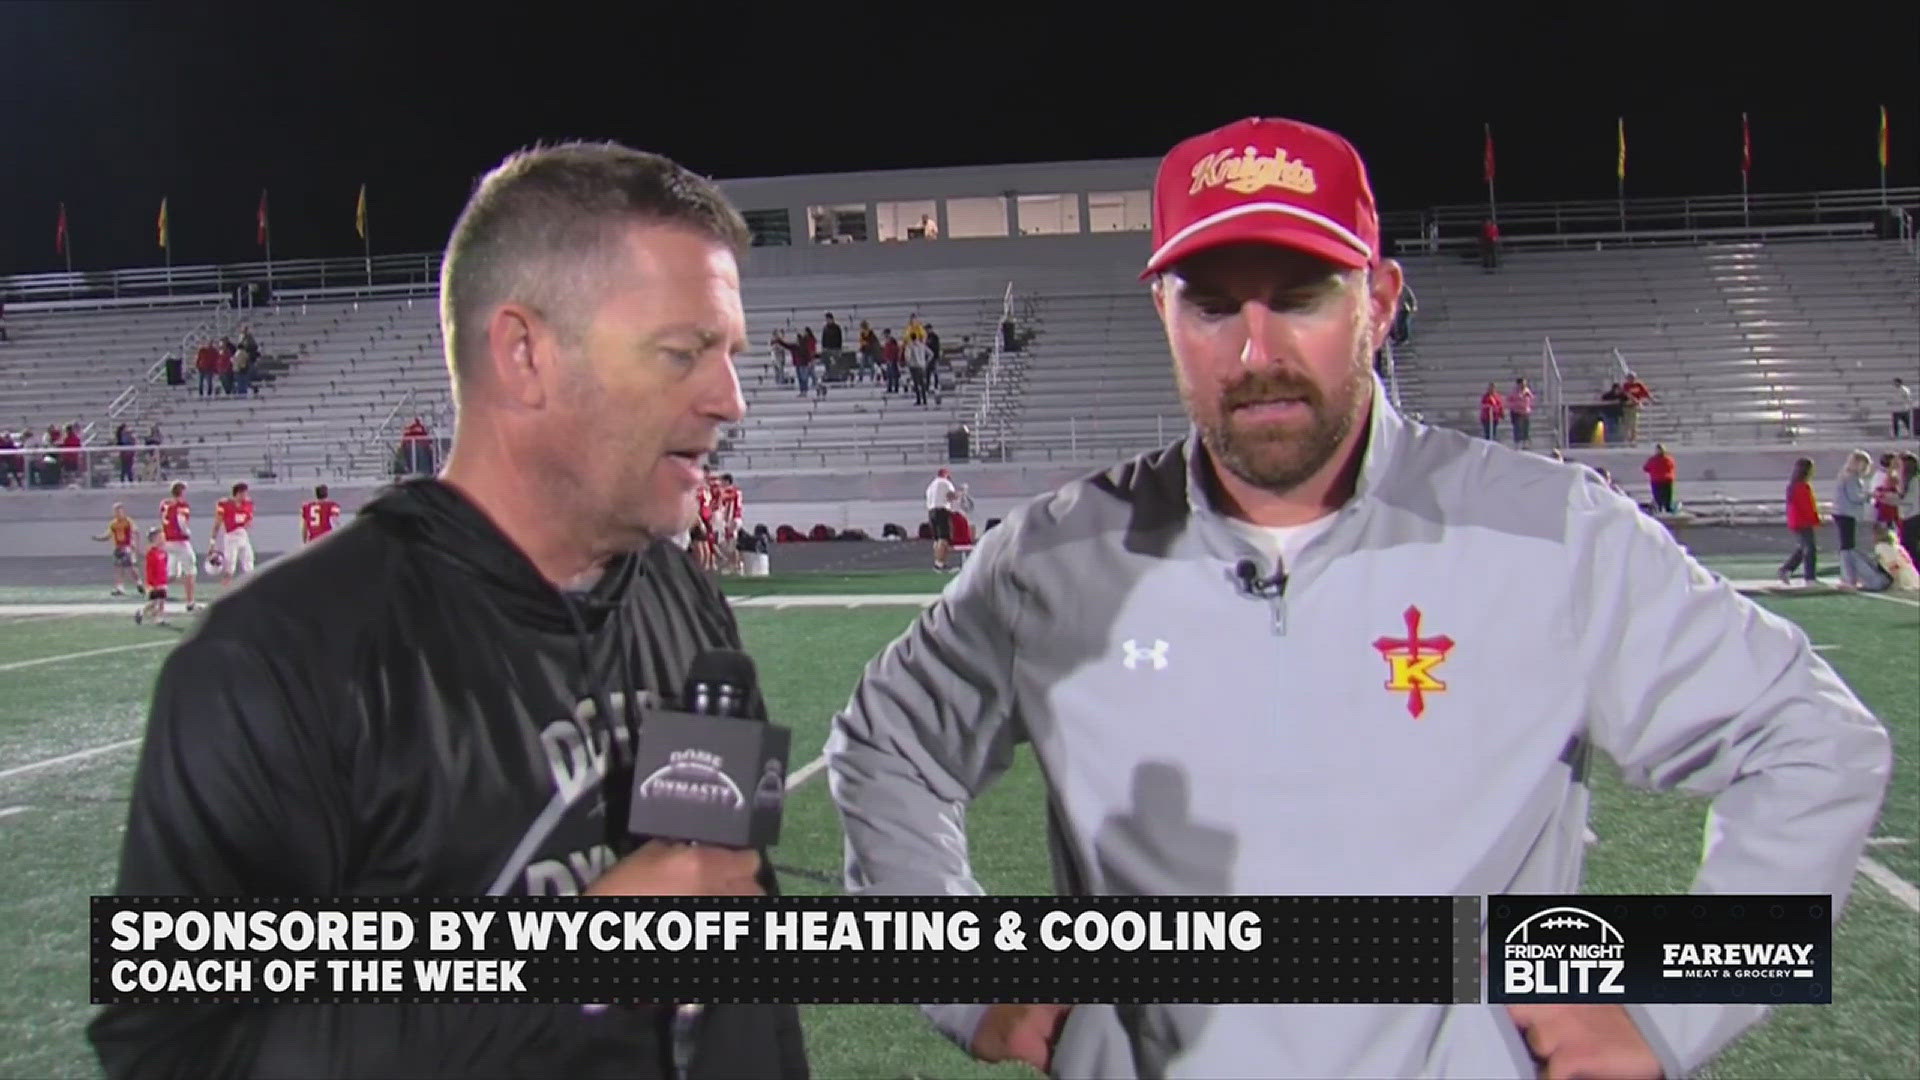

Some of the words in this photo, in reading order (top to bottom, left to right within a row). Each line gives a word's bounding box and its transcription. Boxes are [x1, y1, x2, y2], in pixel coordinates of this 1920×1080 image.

[1189, 146, 1317, 196] Knights
[309, 503, 321, 527] 5
[1384, 652, 1446, 691] K
[652, 779, 731, 798] DYNASTY
